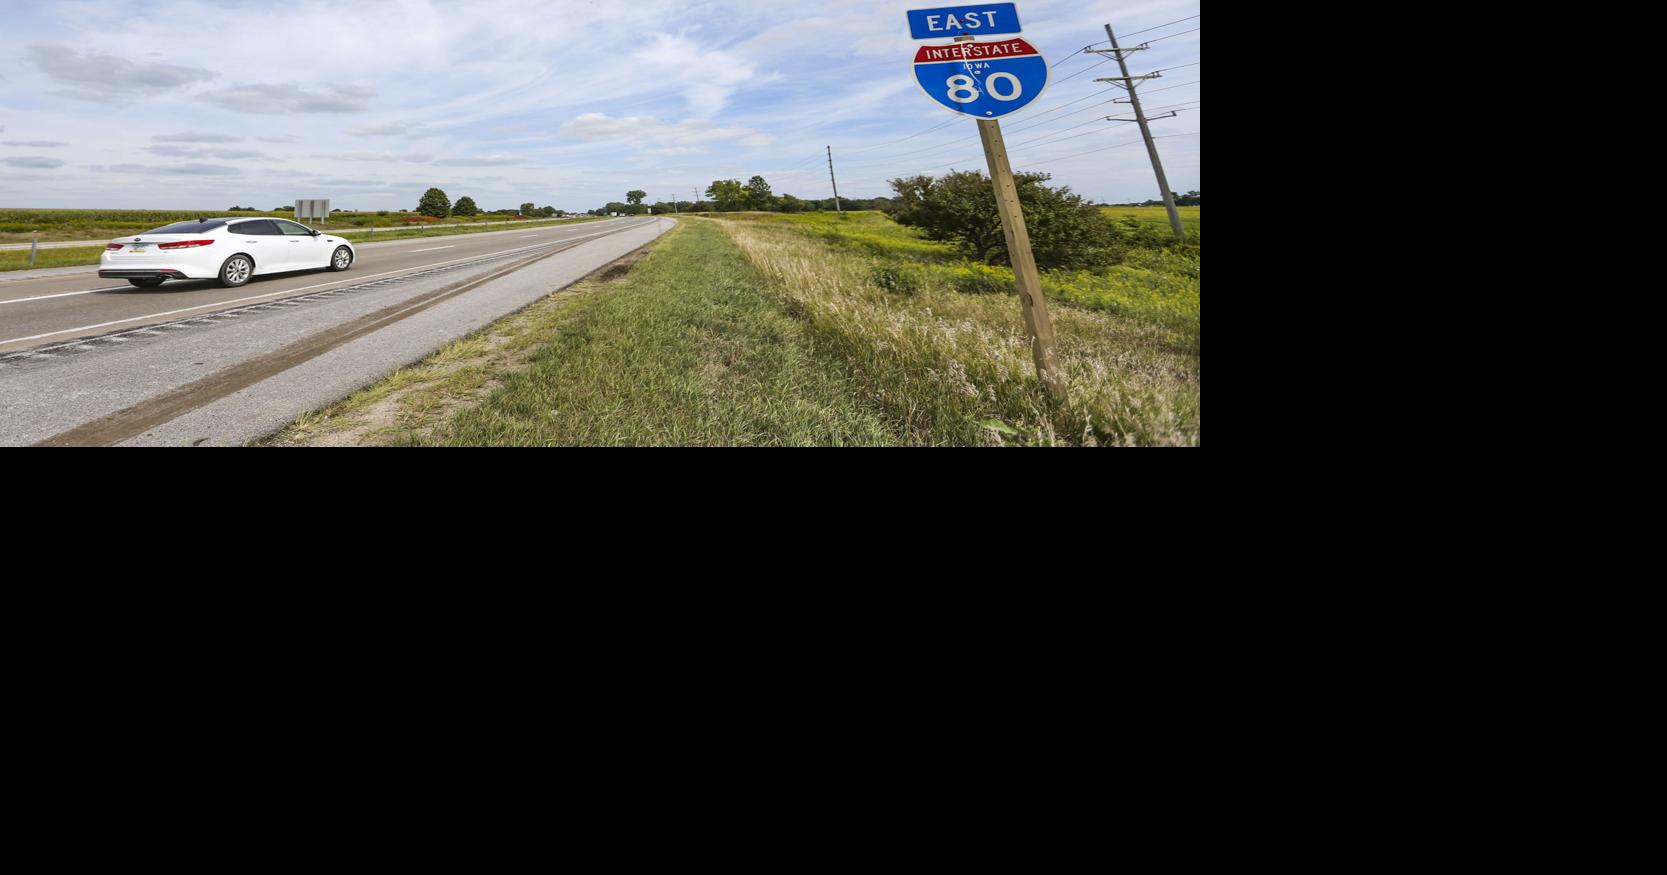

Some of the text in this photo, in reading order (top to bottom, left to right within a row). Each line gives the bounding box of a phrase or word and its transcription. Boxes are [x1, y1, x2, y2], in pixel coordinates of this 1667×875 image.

[927, 11, 997, 32] EAST
[926, 43, 1022, 59] INTERSTATE
[963, 62, 990, 70] IOWA
[946, 72, 1022, 103] 80
